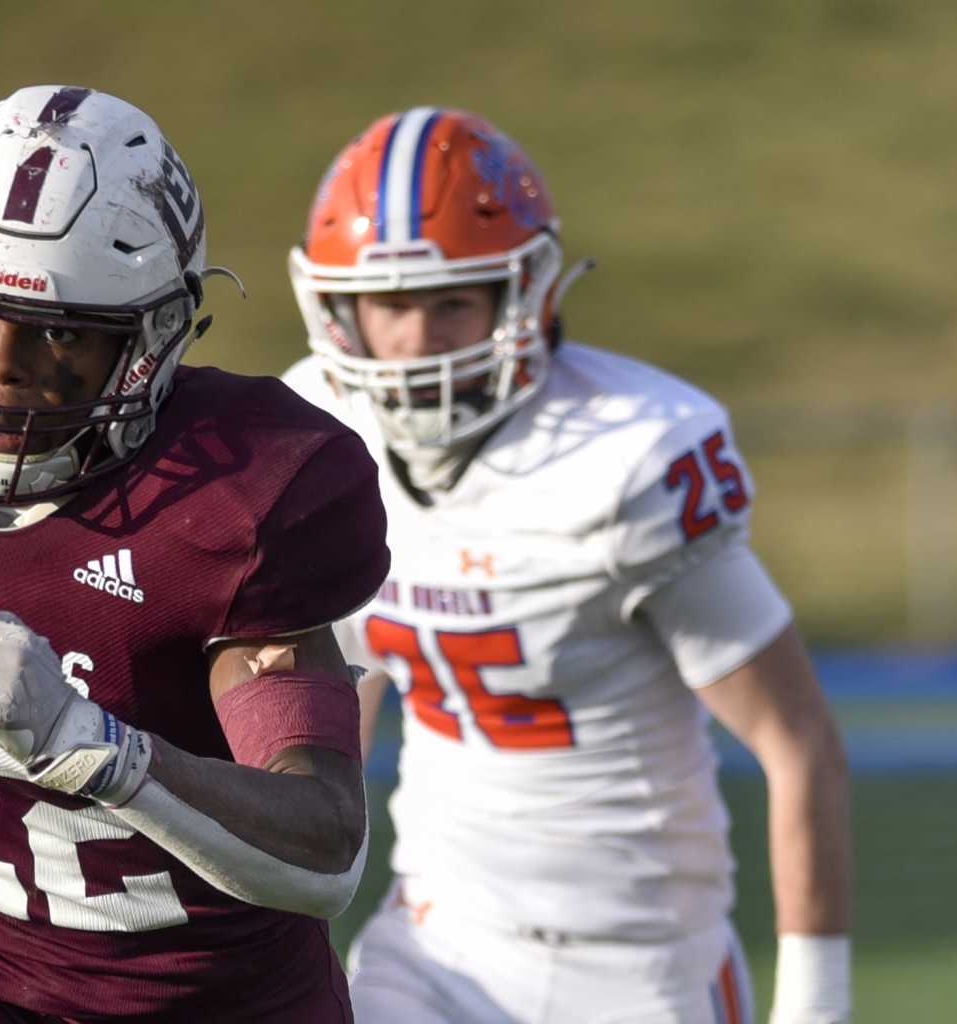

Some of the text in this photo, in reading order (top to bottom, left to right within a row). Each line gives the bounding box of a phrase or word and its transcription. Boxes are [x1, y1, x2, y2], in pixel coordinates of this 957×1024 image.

[665, 430, 750, 541] 25
[73, 567, 145, 603] adidas
[365, 613, 575, 750] 25
